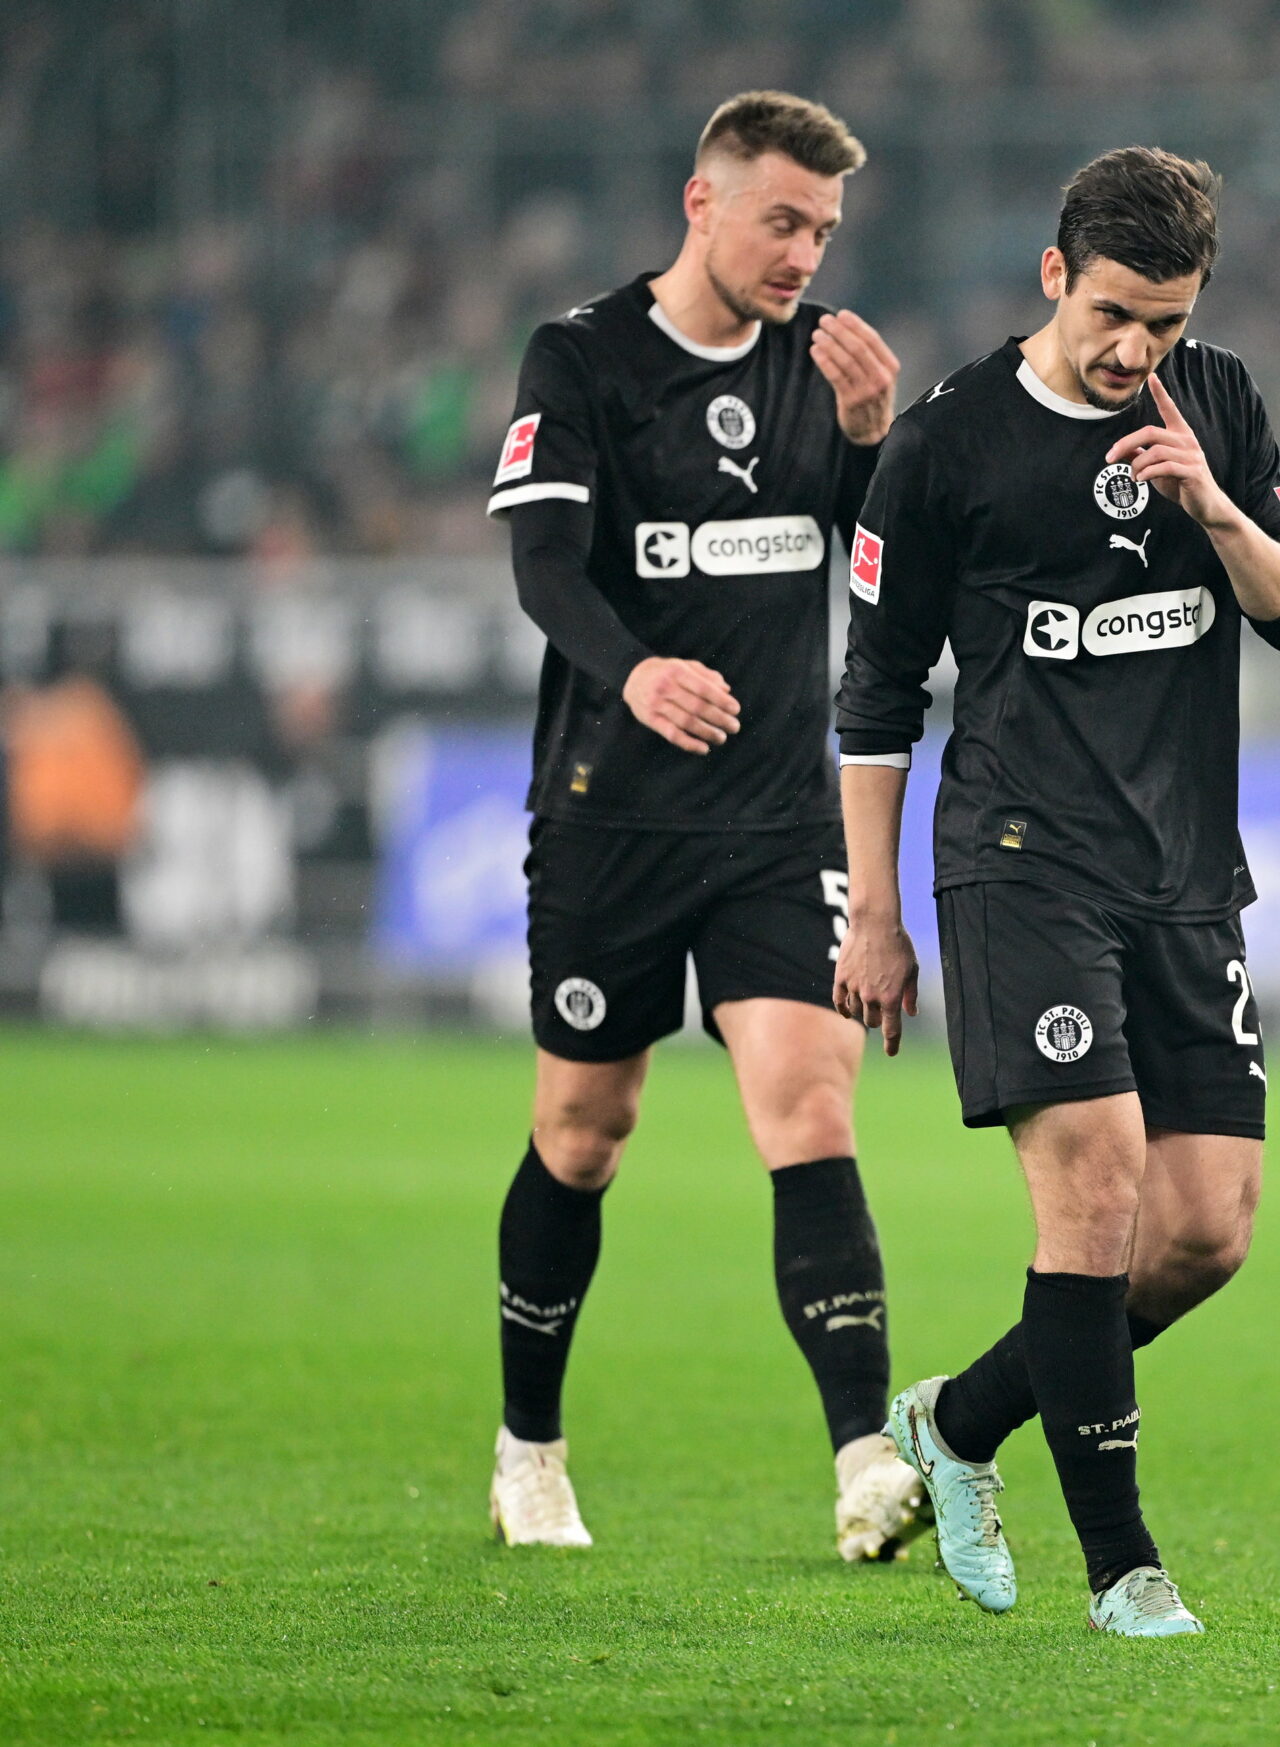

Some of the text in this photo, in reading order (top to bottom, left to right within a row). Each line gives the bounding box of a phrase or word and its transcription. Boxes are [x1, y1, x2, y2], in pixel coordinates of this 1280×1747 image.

[1095, 465, 1146, 495] FC ST. PAI
[1117, 507, 1138, 518] 1910
[820, 870, 849, 961] 5
[1226, 960, 1263, 1046] 2
[1037, 1007, 1091, 1036] FC ST. PAULI
[1055, 1050, 1079, 1061] 1910
[1078, 1423, 1109, 1436] ST.
